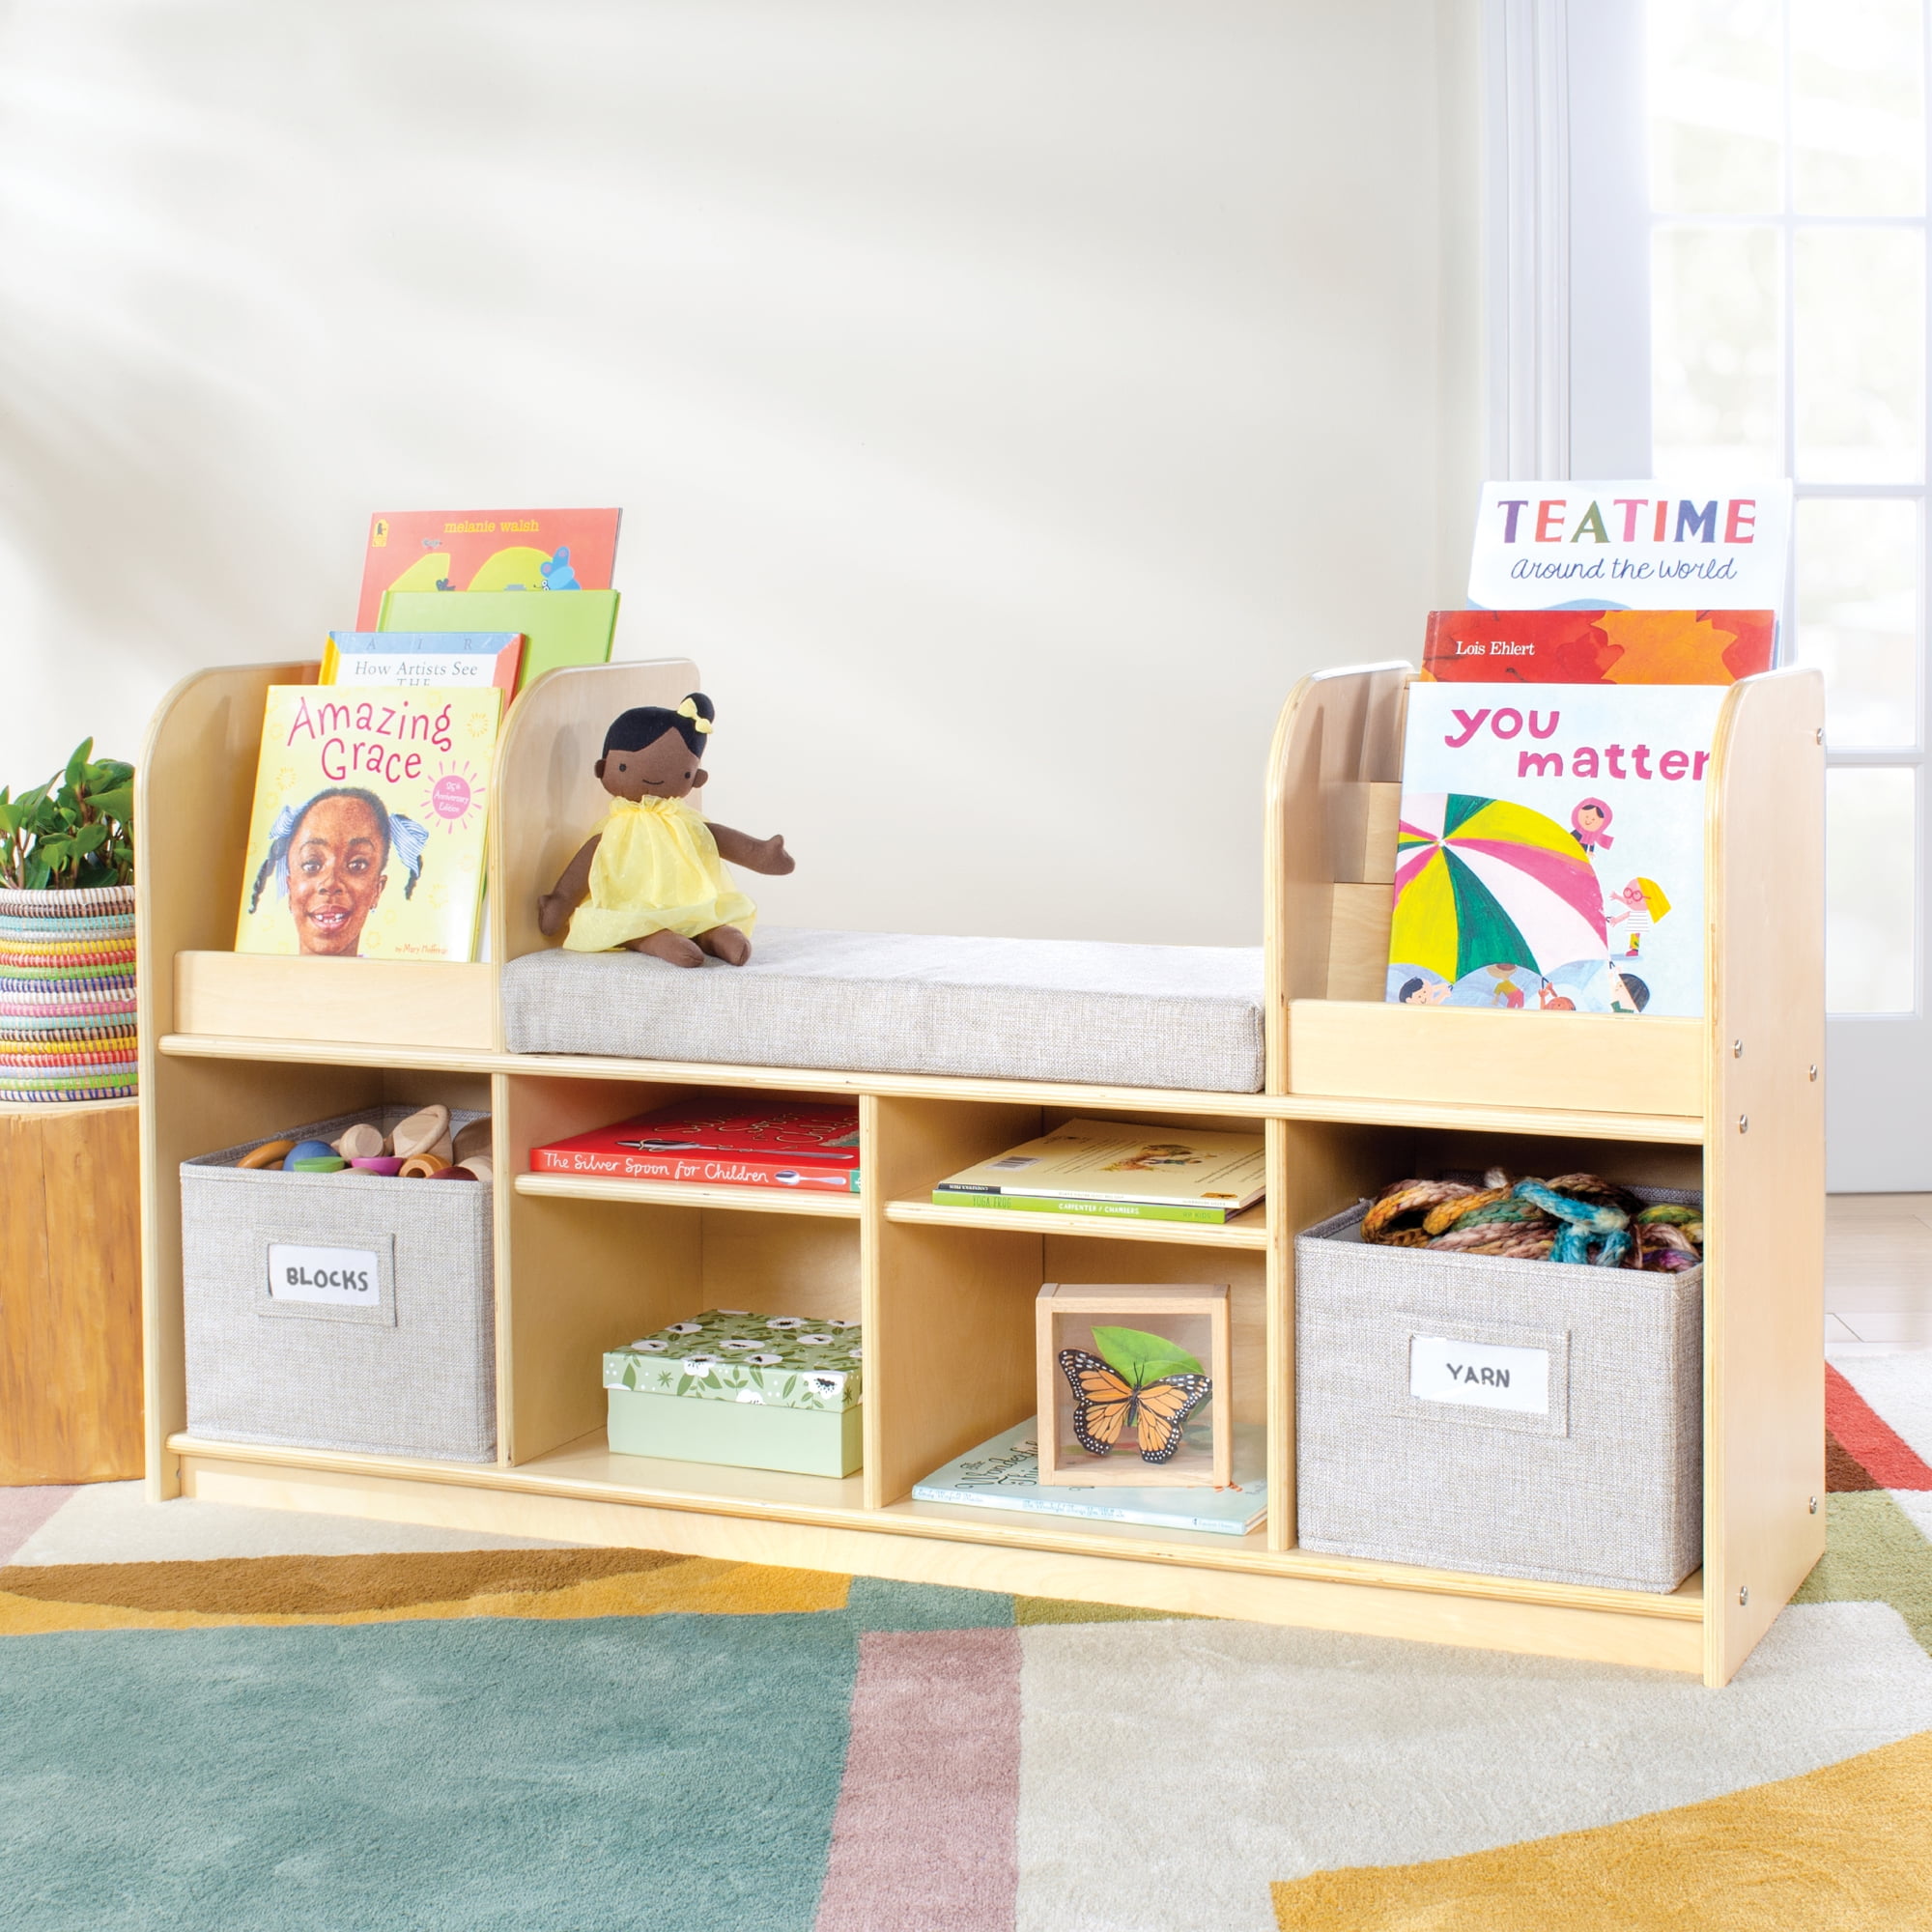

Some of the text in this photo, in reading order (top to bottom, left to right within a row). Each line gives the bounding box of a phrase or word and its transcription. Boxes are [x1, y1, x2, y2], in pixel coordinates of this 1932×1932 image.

[443, 519, 539, 533] melanie walsh
[1497, 498, 1756, 544] TEATIME
[1611, 557, 1654, 580] the
[1456, 640, 1535, 656] Lois Ehlert
[355, 661, 478, 676] How Artists See
[287, 696, 452, 752] Amazing
[1444, 707, 1560, 749] you
[321, 737, 422, 783] Grace
[1518, 744, 1710, 781] matter
[544, 1151, 569, 1169] The
[574, 1152, 619, 1173] Silver
[625, 1158, 669, 1177] Spoon
[704, 1162, 769, 1183] Children
[972, 1195, 1011, 1208] YOGA FROG
[1059, 1203, 1096, 1212] CARPENTER
[1104, 1206, 1140, 1215] CHAMBERS
[286, 1266, 369, 1292] BLOCKS
[1446, 1362, 1511, 1388] YARN
